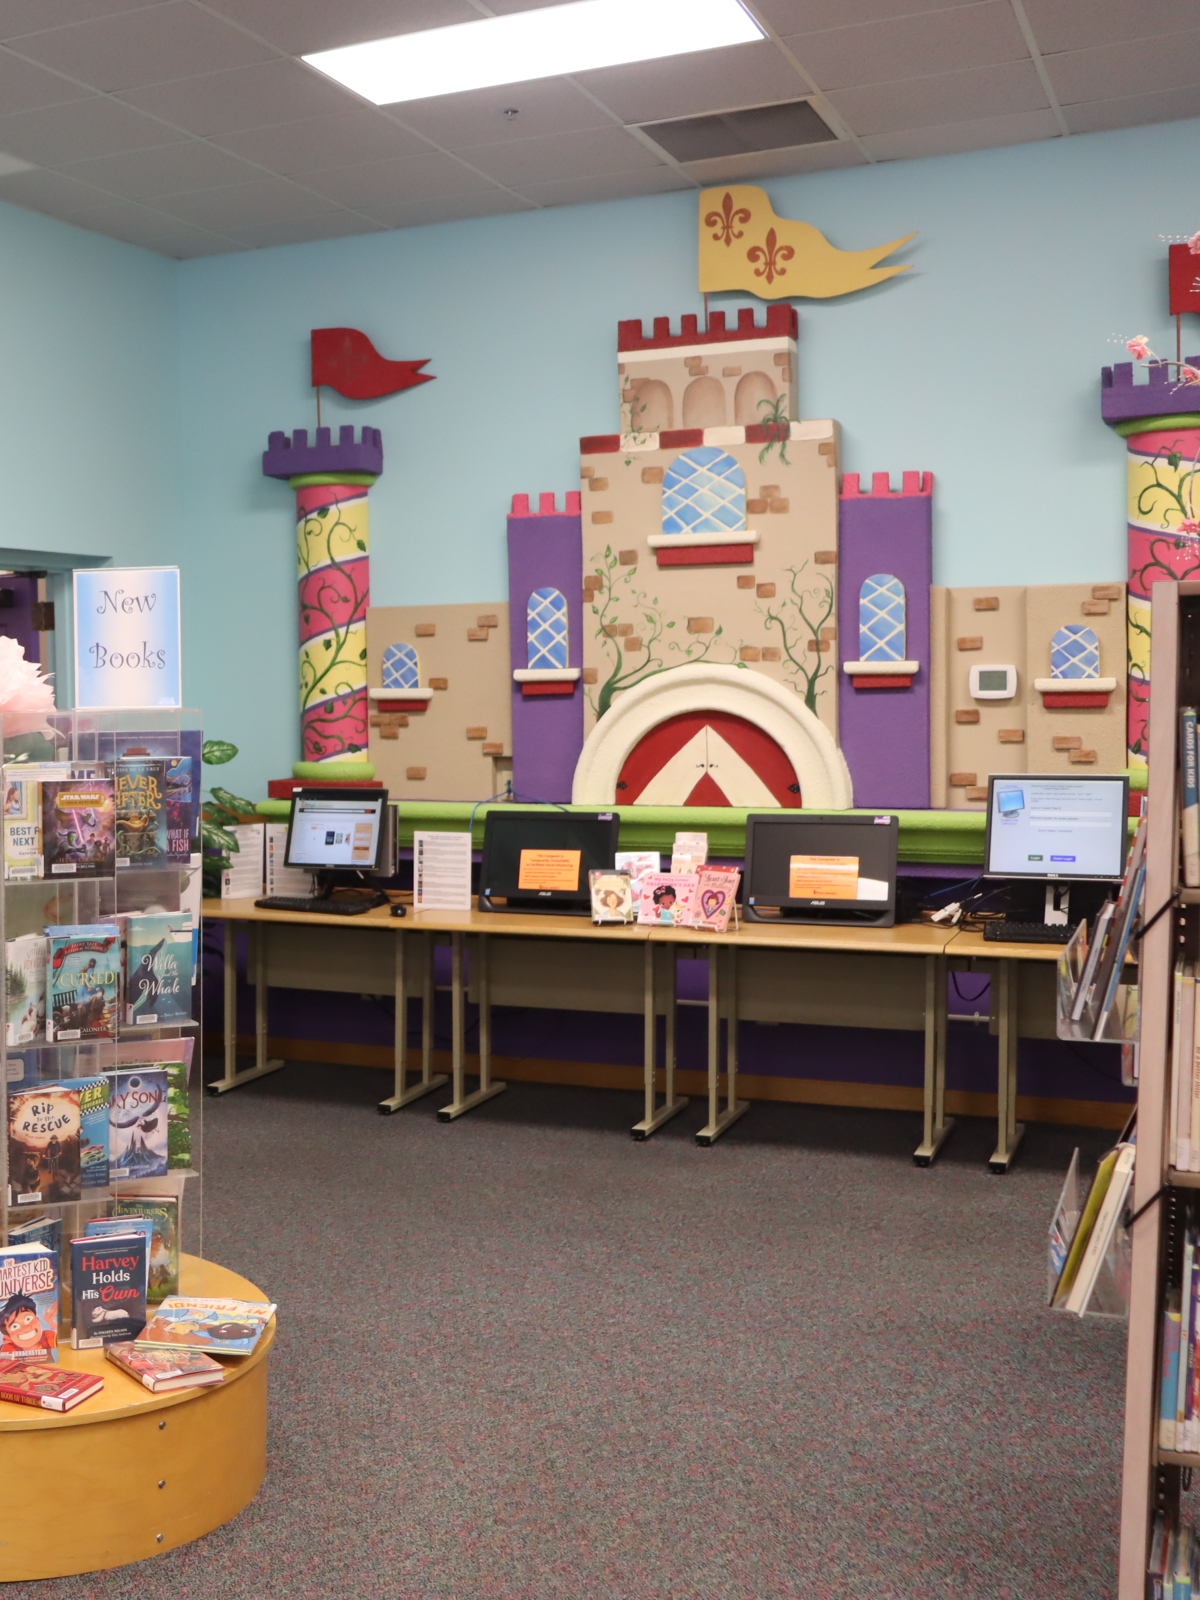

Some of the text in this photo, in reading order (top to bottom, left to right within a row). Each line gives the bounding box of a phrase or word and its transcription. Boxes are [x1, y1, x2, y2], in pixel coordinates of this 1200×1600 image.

[96, 589, 157, 614] New
[88, 640, 166, 670] Books
[1186, 721, 1194, 750] CARDS
[1187, 768, 1195, 788] KIDS
[10, 826, 33, 836] BEST
[184, 828, 190, 838] IF
[13, 837, 35, 846] NEXT
[172, 839, 189, 852] FISH
[141, 953, 178, 972] Willa
[60, 971, 115, 988] CURSED
[138, 977, 180, 996] Whale
[130, 1089, 167, 1109] SONG
[31, 1102, 54, 1117] Rip
[22, 1114, 71, 1133] RESCUE
[34, 1259, 49, 1274] KID
[82, 1255, 140, 1271] Harvey
[92, 1270, 131, 1284] Holds
[82, 1285, 140, 1301] His Own
[1, 1391, 14, 1400] BOOK
[21, 1394, 38, 1405] THREE
